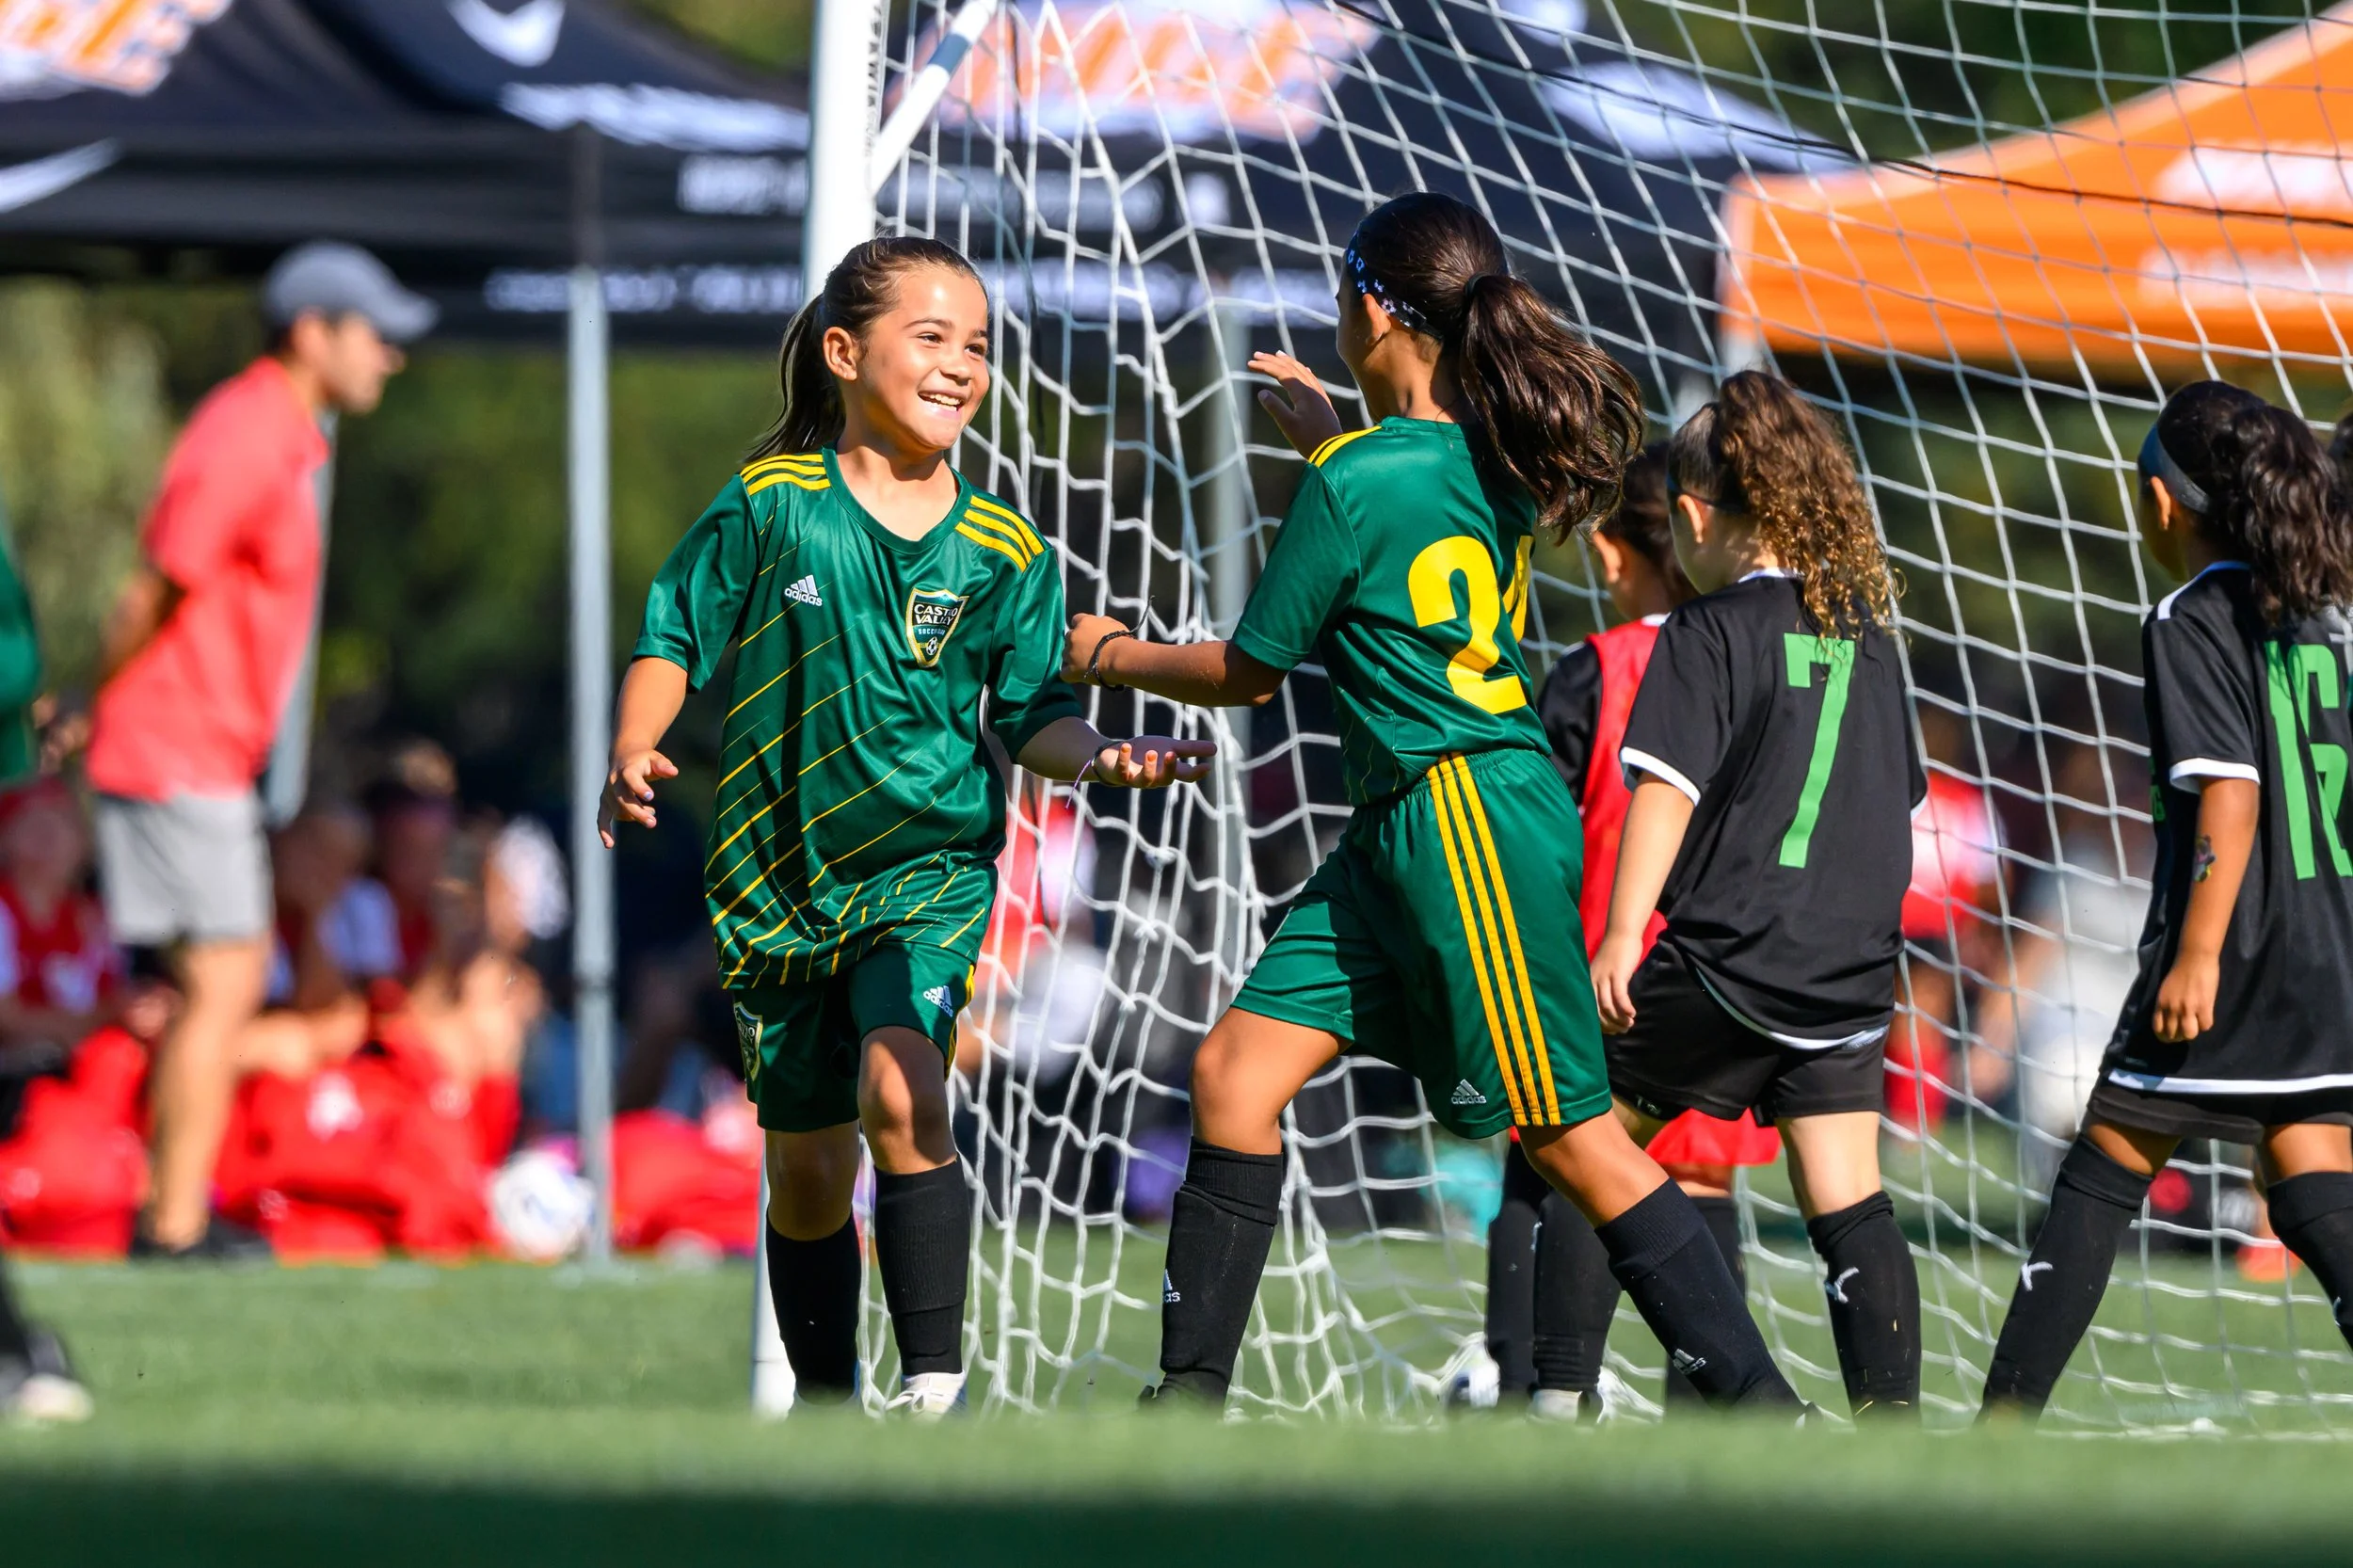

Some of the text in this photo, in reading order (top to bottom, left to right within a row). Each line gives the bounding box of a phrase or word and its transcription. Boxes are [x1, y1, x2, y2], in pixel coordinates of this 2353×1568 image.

[784, 587, 823, 606] adidas
[1779, 632, 1855, 868] 7
[2264, 640, 2353, 880] 16
[923, 990, 953, 1017] adidas
[1451, 1095, 1487, 1105] adidas
